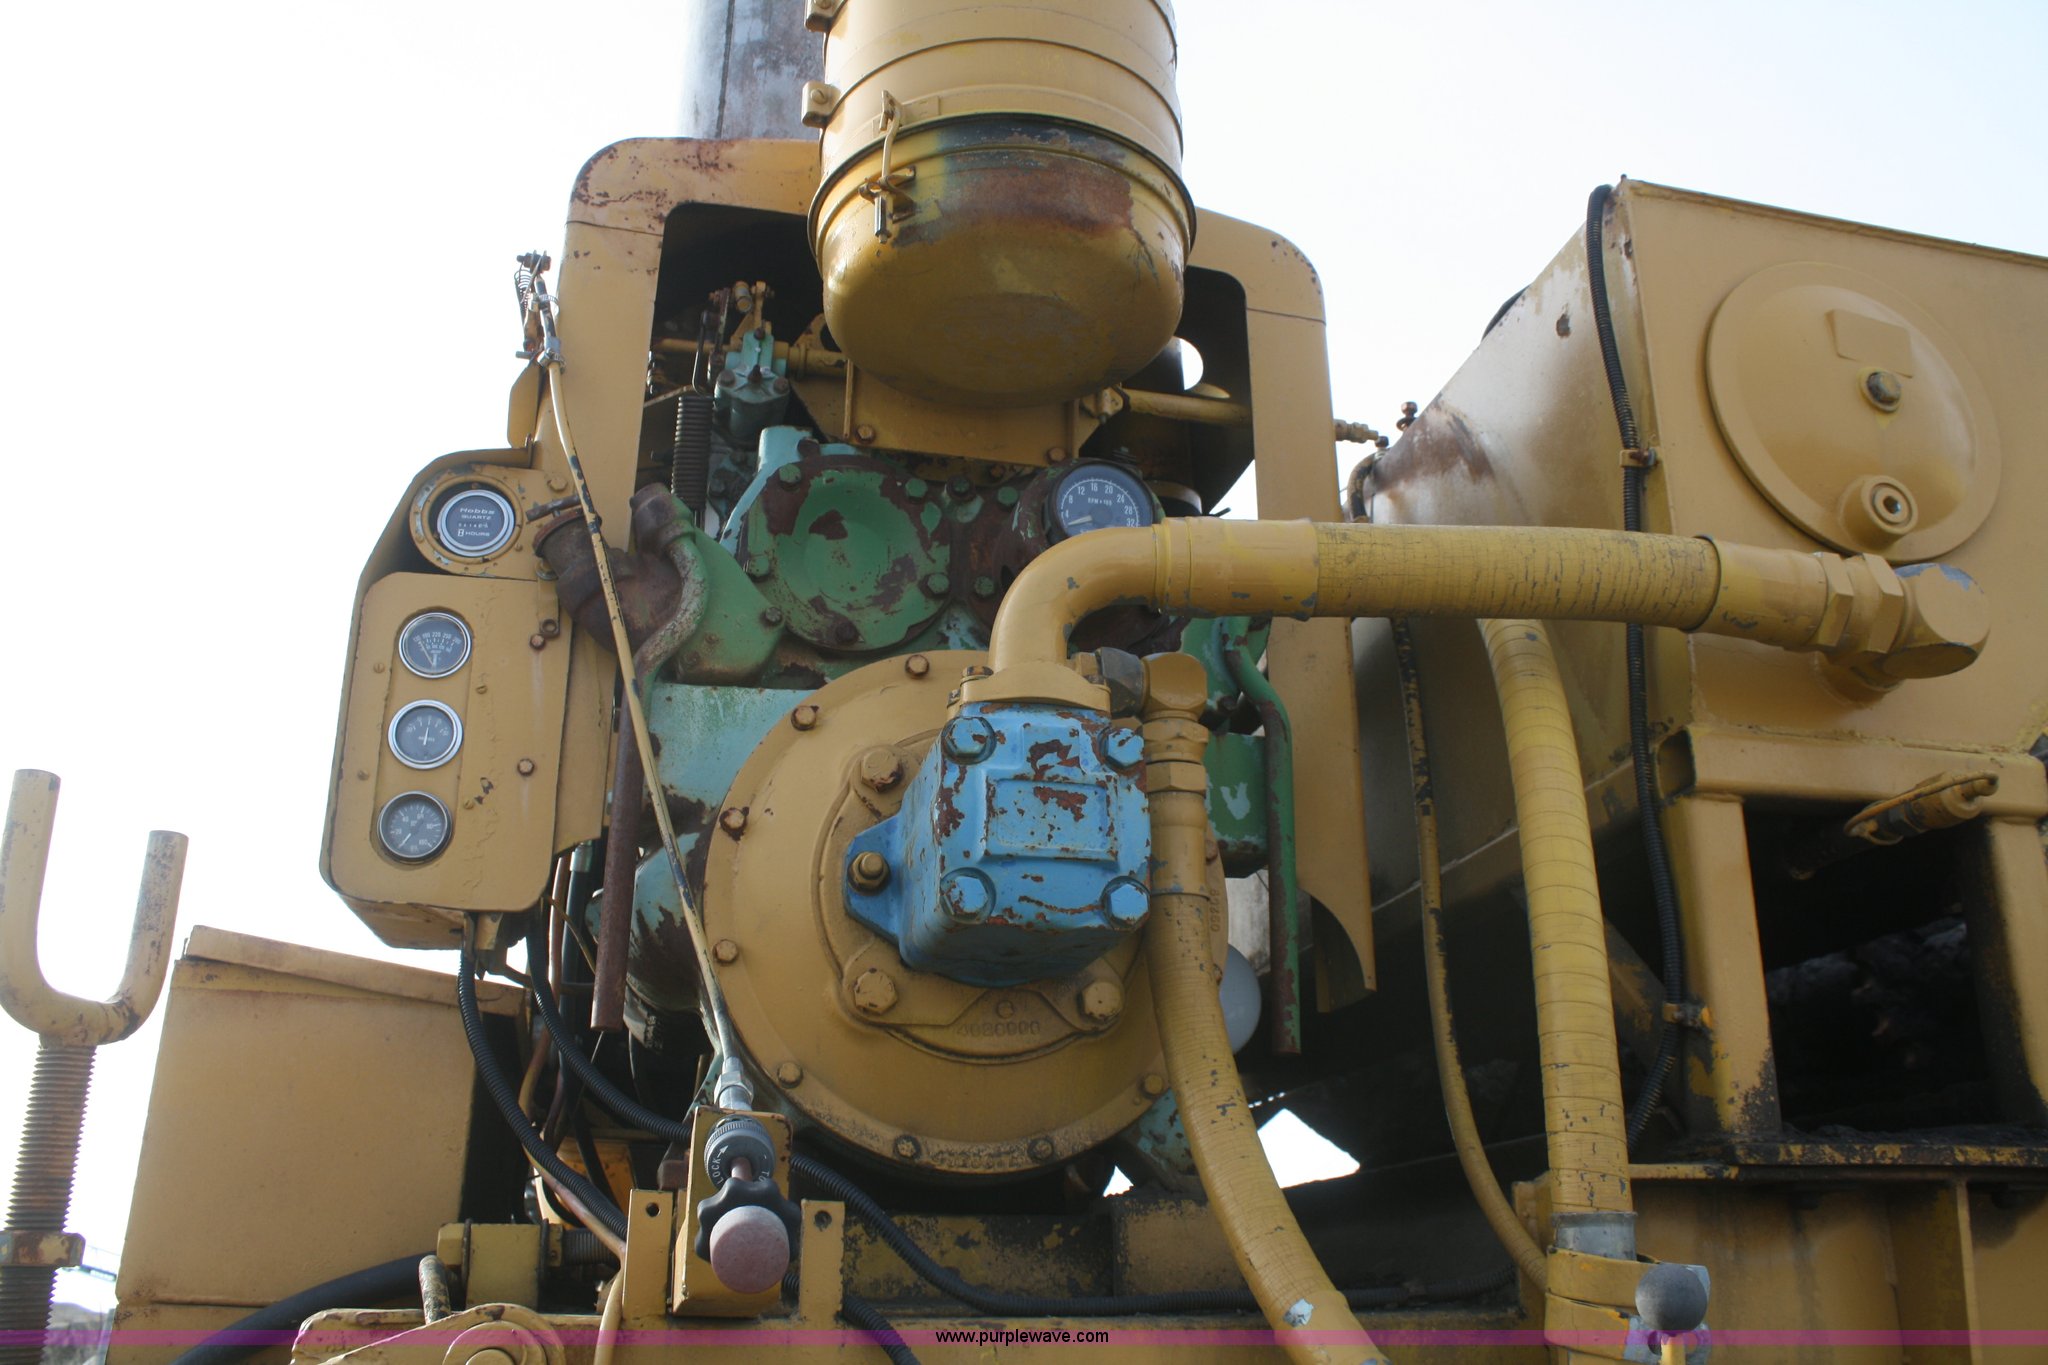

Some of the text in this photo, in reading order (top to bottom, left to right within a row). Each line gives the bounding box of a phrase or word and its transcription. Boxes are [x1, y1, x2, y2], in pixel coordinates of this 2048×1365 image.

[1078, 486, 1085, 495] 12
[1091, 482, 1098, 492] 16
[1104, 485, 1113, 494] 20
[1068, 495, 1073, 504] 8
[1117, 494, 1125, 503] 24
[1065, 509, 1069, 518] 4
[1124, 505, 1133, 515] 28
[1126, 517, 1135, 528] 32
[711, 1158, 724, 1184] LOCK
